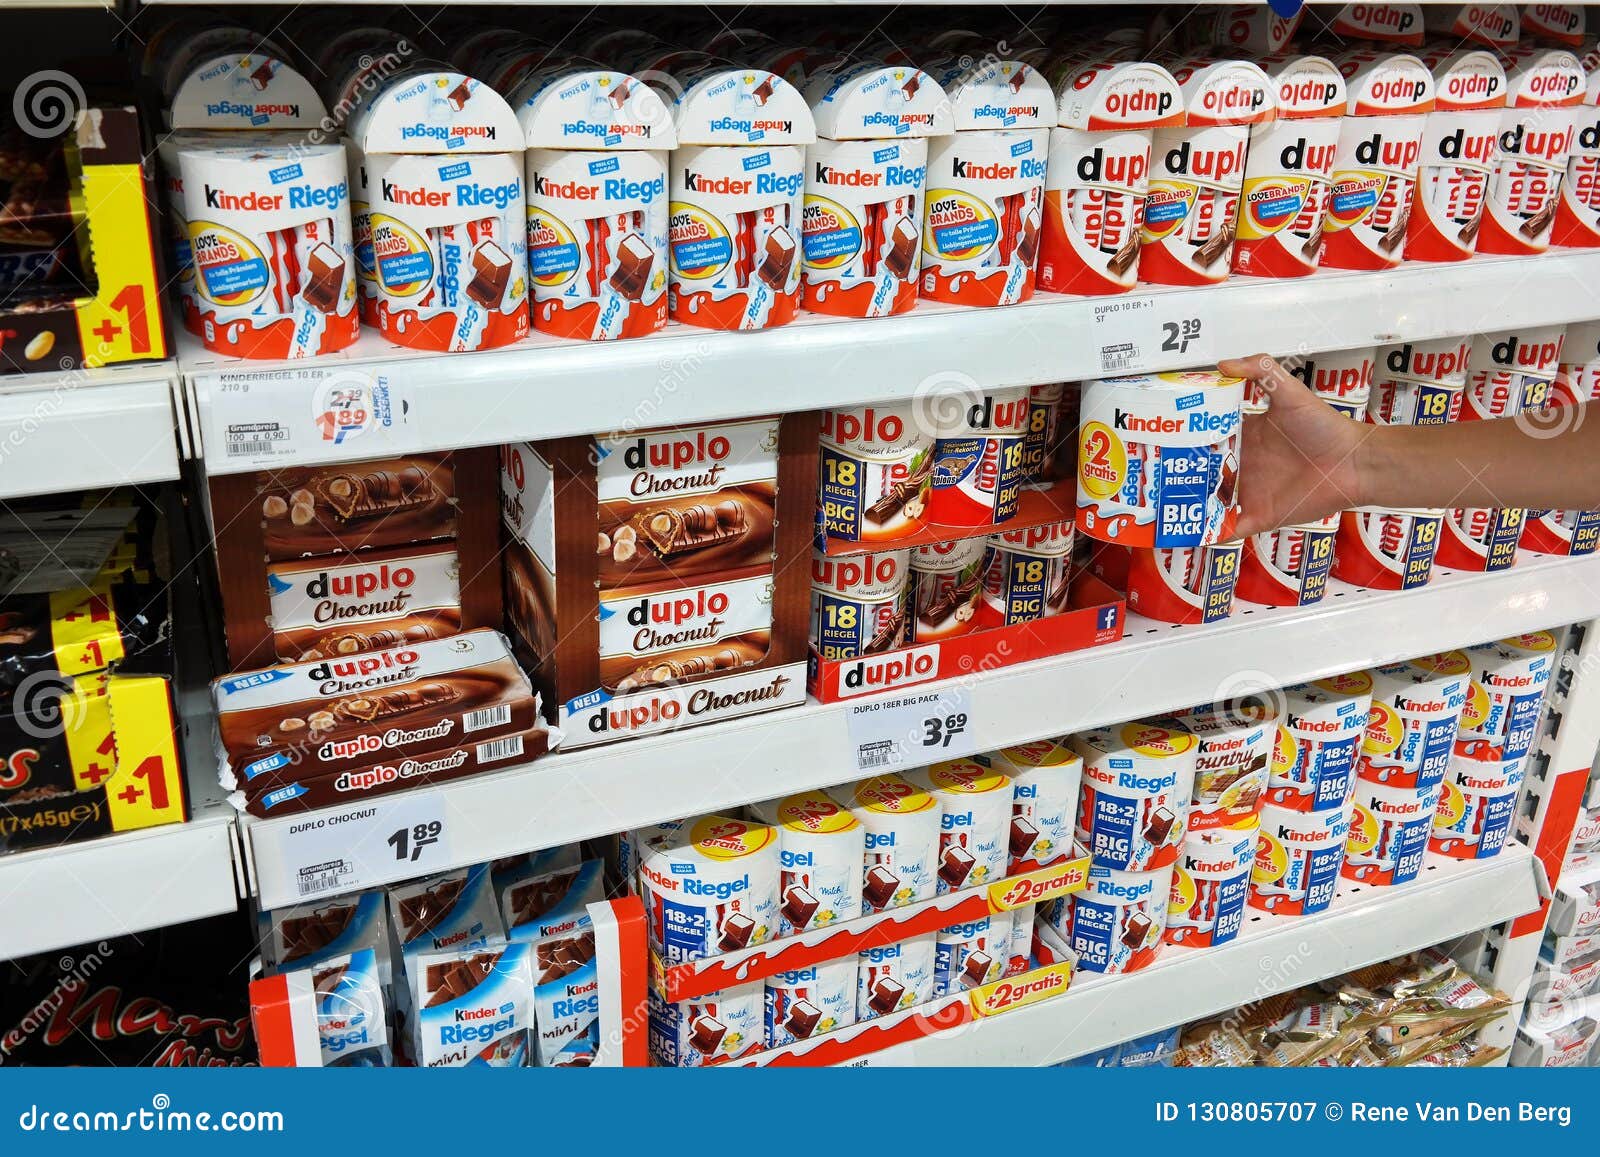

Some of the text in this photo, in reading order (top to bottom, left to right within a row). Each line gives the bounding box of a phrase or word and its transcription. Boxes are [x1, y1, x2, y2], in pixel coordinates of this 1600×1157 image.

[1279, 79, 1337, 105] duplo
[1371, 79, 1425, 103] duplo
[1449, 74, 1498, 98] duplo
[1106, 89, 1172, 117] duplo
[1203, 86, 1264, 111] duplo
[864, 112, 899, 127] Riegel
[974, 105, 1007, 119] Riegel
[402, 124, 448, 139] Riegel
[710, 117, 750, 132] Riegel
[816, 162, 882, 186] kinder
[953, 158, 1016, 180] kinder
[534, 172, 664, 203] kinder Riegel
[685, 169, 752, 194] kinder
[205, 184, 283, 210] kinder
[382, 177, 520, 209] kinder Riegel
[931, 200, 957, 214] LOVE
[930, 208, 974, 225] BRANDS
[93, 284, 151, 353] +1
[1095, 306, 1119, 314] DUPLO
[1162, 319, 1201, 353] 2,39
[220, 372, 293, 382] KINDERRIEGEL
[1525, 382, 1547, 405] 18
[1422, 392, 1448, 416] 18
[1114, 408, 1184, 433] kinder
[624, 432, 730, 469] duplo
[1004, 442, 1023, 470] 18
[826, 459, 856, 486] 18
[1085, 462, 1117, 482] gratis
[1163, 457, 1209, 474] 18+2
[630, 464, 726, 496] Chocnut
[1165, 476, 1205, 486] RIEGEL
[826, 485, 857, 498] RIEGEL
[825, 501, 855, 521] BIG
[1163, 504, 1203, 522] BIG
[1501, 508, 1522, 528] 18
[1163, 523, 1203, 536] PACK
[1415, 521, 1436, 545] 18
[1496, 526, 1518, 537] RIEGEL
[1311, 536, 1333, 560] 18
[1412, 543, 1433, 554] RIEGEL
[1493, 543, 1515, 557] BIG
[1575, 539, 1598, 551] PACK
[1015, 560, 1044, 582] 18
[1214, 552, 1235, 577] 18
[1308, 558, 1328, 570] RIEGEL
[306, 564, 416, 599] duplo
[1013, 583, 1043, 592] RIEGEL
[1407, 572, 1428, 585] PACK
[1303, 588, 1324, 601] PACK
[314, 591, 412, 624] Chocnut
[627, 590, 729, 626] duplo
[825, 605, 857, 628] 18
[1011, 601, 1041, 614] BIG
[633, 617, 725, 650] Chocnut
[823, 629, 857, 639] RIEGEL
[80, 639, 104, 666] +1
[308, 650, 420, 682] duplo
[844, 653, 933, 689] duplo
[234, 672, 275, 690] NEU
[319, 666, 421, 696] Chocnut
[573, 692, 600, 710] NEU
[588, 674, 791, 732] duplo Chocnut
[854, 694, 939, 714] DUPLO 18ER BIG PACK
[1394, 695, 1446, 713] kinder
[1514, 701, 1540, 713] 18+2
[923, 713, 968, 747] 3,69
[1287, 713, 1341, 733] kinder
[319, 719, 454, 761] duplo Chocnut
[1509, 729, 1532, 744] BIG
[1323, 747, 1353, 759] 18+2
[1507, 740, 1530, 753] PACK
[251, 757, 279, 774] NEU
[1196, 749, 1253, 770] ountry
[1323, 756, 1350, 768] RIEGEL
[1423, 757, 1447, 772] BIG
[336, 751, 468, 791] duplo Chocnut
[1421, 766, 1444, 779] PACK
[118, 755, 170, 810] +1
[1118, 772, 1177, 793] Riegel
[1320, 778, 1347, 794] BIG
[1456, 772, 1506, 789] kinder
[269, 786, 296, 803] NEU
[1318, 789, 1345, 802] PACK
[1097, 800, 1135, 818] 18+2
[1370, 797, 1421, 814] kinder
[1488, 799, 1514, 812] 18+2
[290, 808, 377, 834] DUPLO CHOCNUT
[1097, 813, 1131, 826] RIEGEL
[387, 821, 442, 861] 1,89
[1278, 825, 1330, 842] kinder
[1483, 829, 1505, 843] BIG
[701, 838, 748, 852] gratis
[1094, 834, 1129, 852] BIG
[1481, 838, 1503, 851] PACK
[1185, 856, 1237, 872] kinder
[1313, 850, 1340, 867] 18+2
[1399, 853, 1421, 868] BIG
[1397, 863, 1419, 876] PACK
[683, 874, 750, 899] Riegel
[1097, 880, 1153, 900] Riegel
[1308, 882, 1333, 899] BIG
[1307, 892, 1332, 907] PACK
[664, 908, 705, 928] 18+2
[1077, 905, 1113, 923] 18+2
[1217, 910, 1241, 929] BIG
[666, 923, 703, 936] RIEGEL
[1077, 917, 1110, 931] RIEGEL
[1217, 921, 1240, 938] PACK
[1075, 936, 1107, 956] BIG
[455, 1006, 498, 1022] kinder
[439, 1014, 516, 1045] Riegel
[542, 1018, 579, 1041] mini
[428, 1045, 468, 1067] mini
